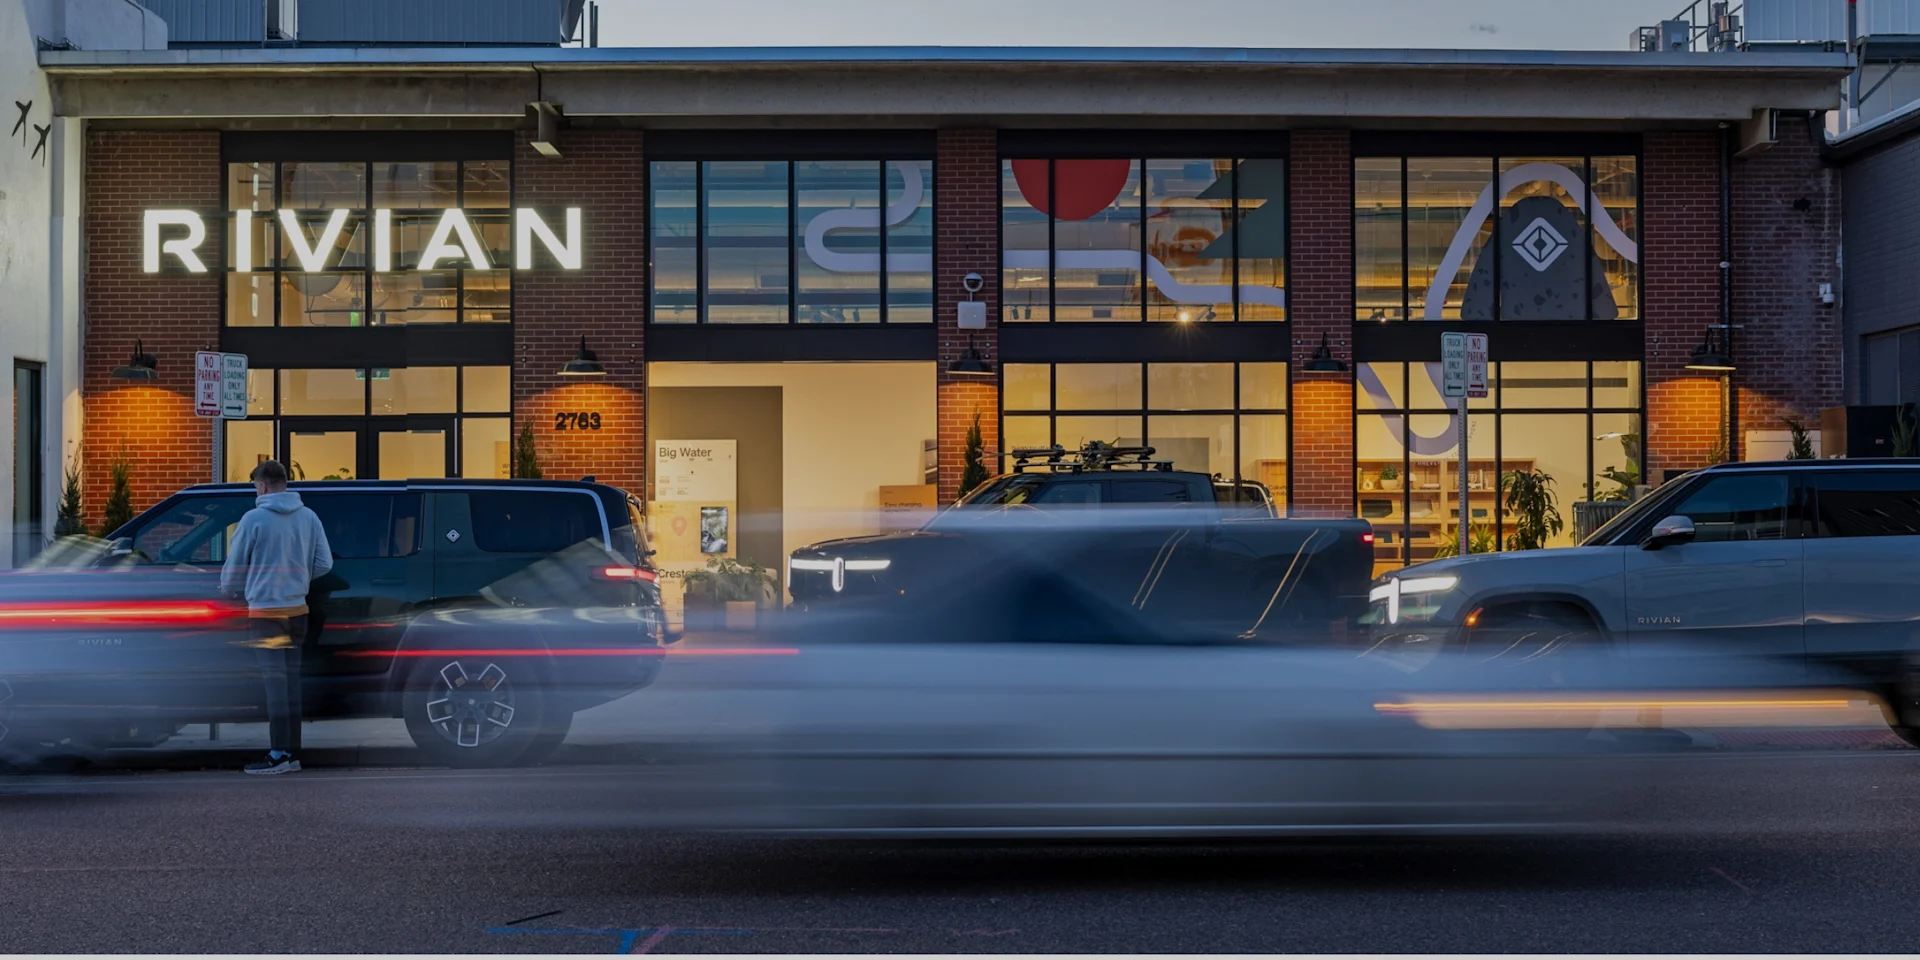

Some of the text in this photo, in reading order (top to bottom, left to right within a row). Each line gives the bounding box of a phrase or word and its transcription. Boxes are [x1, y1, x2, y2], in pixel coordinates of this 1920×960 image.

[143, 207, 582, 273] RIVIAN
[1446, 338, 1461, 347] TRUCK
[1472, 338, 1481, 350] NO
[1444, 350, 1464, 359] LOADING
[1467, 351, 1486, 363] PARKING
[204, 356, 214, 368] NO
[227, 359, 242, 368] TRUCK
[1448, 361, 1460, 369] ONLY
[1472, 364, 1481, 372] ANY
[198, 369, 220, 382] PARKING
[224, 371, 245, 380] LOADING
[1471, 373, 1482, 382] TIME
[204, 382, 213, 391] ANY
[228, 382, 241, 390] ONLY
[203, 391, 214, 401] TIME
[224, 392, 245, 401] ALL TIMES
[659, 447, 712, 460] Big Water
[1637, 616, 1681, 625] RIVIAN
